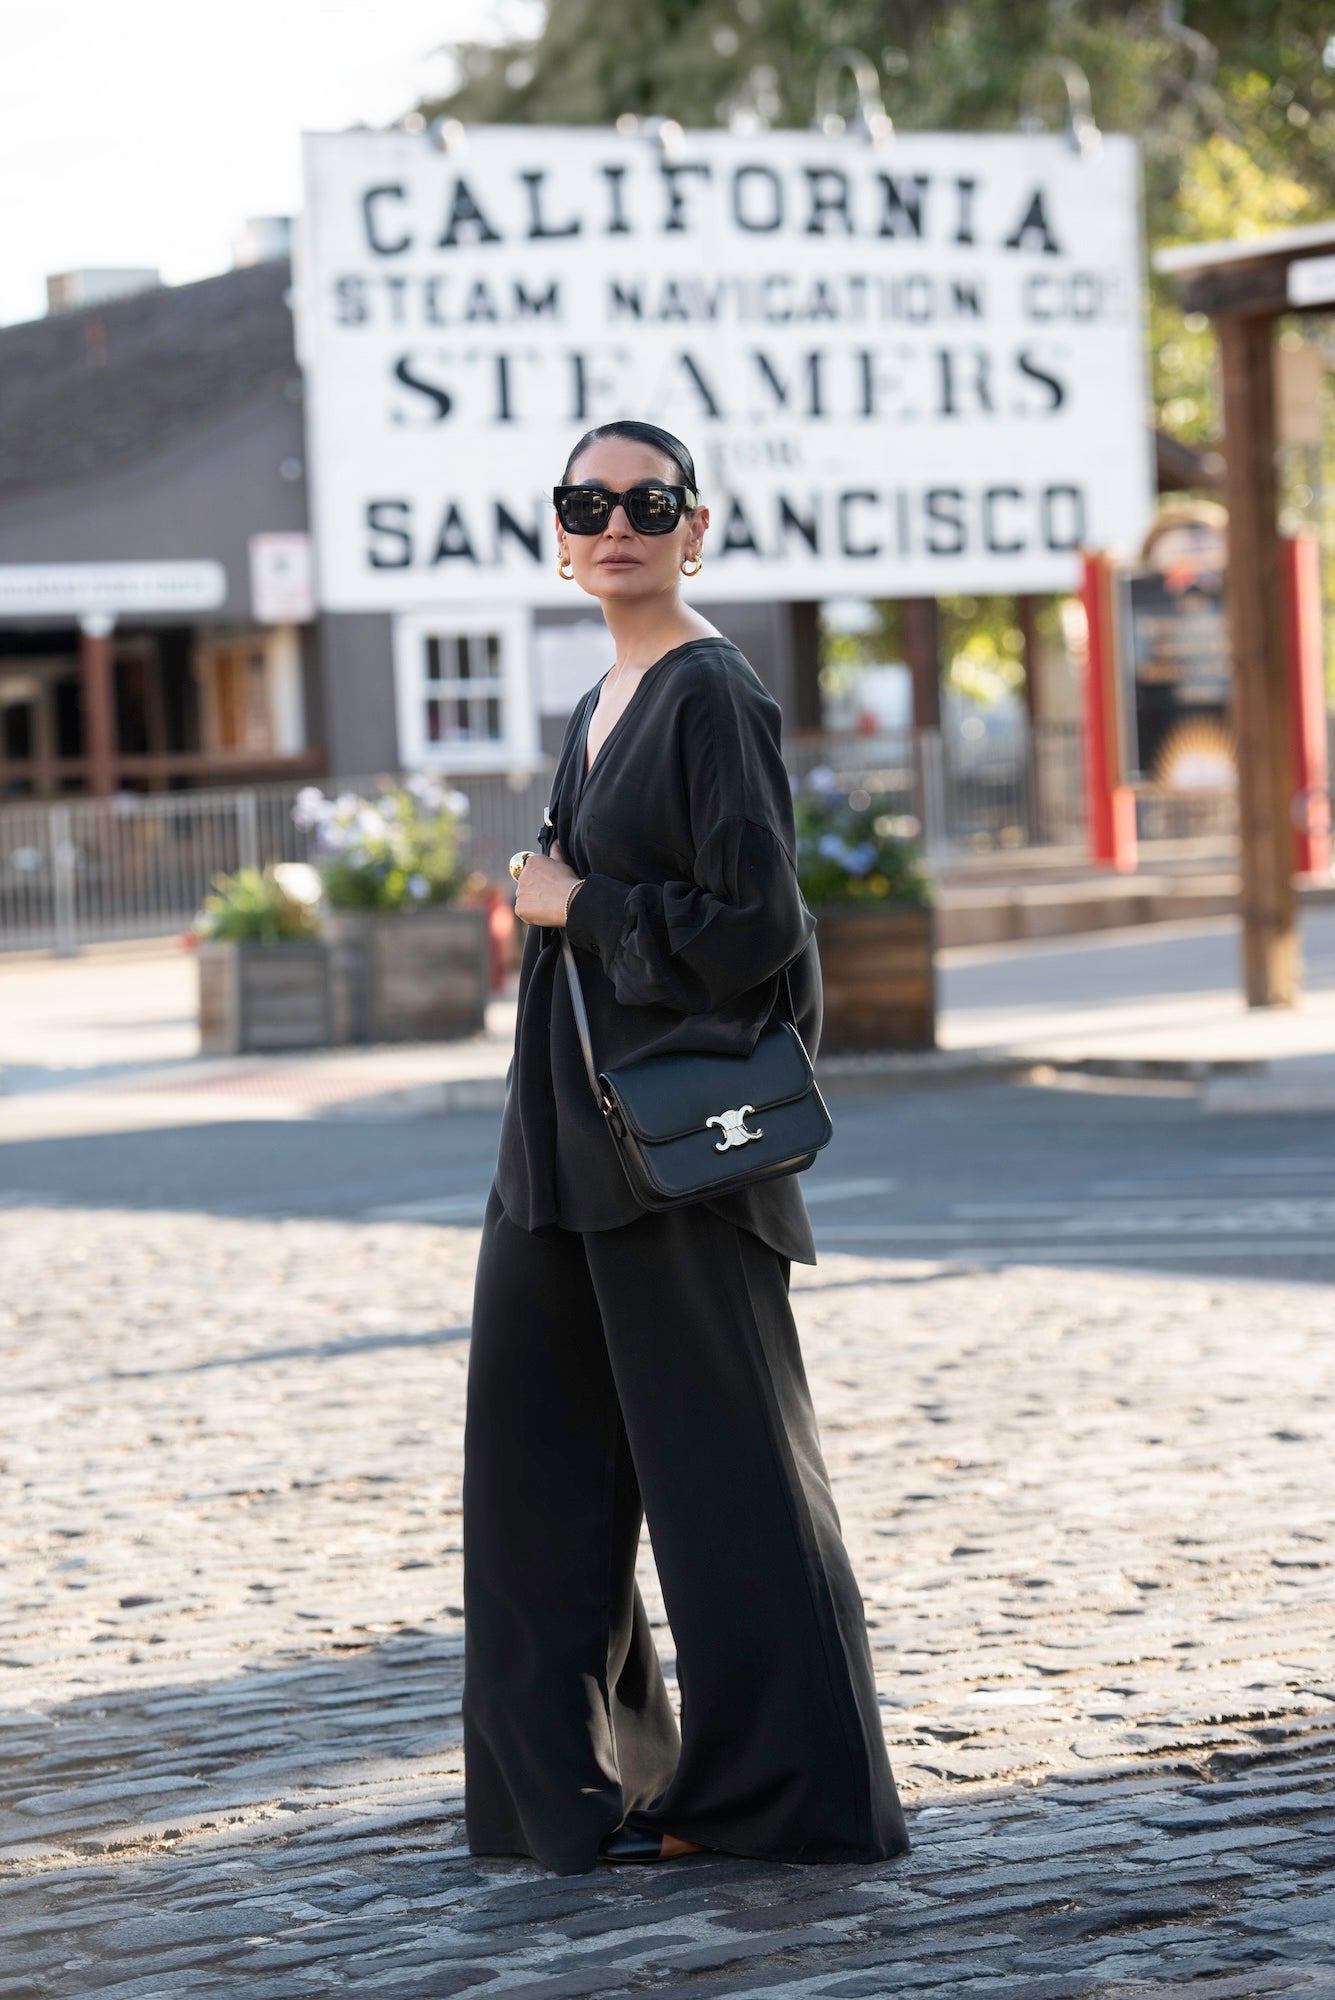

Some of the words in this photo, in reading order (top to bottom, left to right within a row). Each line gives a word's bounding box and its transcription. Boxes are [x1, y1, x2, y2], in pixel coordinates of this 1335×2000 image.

[361, 160, 1062, 257] CALIFORNIA
[334, 273, 562, 326] STEAM
[607, 272, 986, 325] NAVIGATION
[388, 346, 1070, 425] STEAMERS
[366, 500, 550, 570] SAN
[716, 485, 1088, 558] ANCISCO
